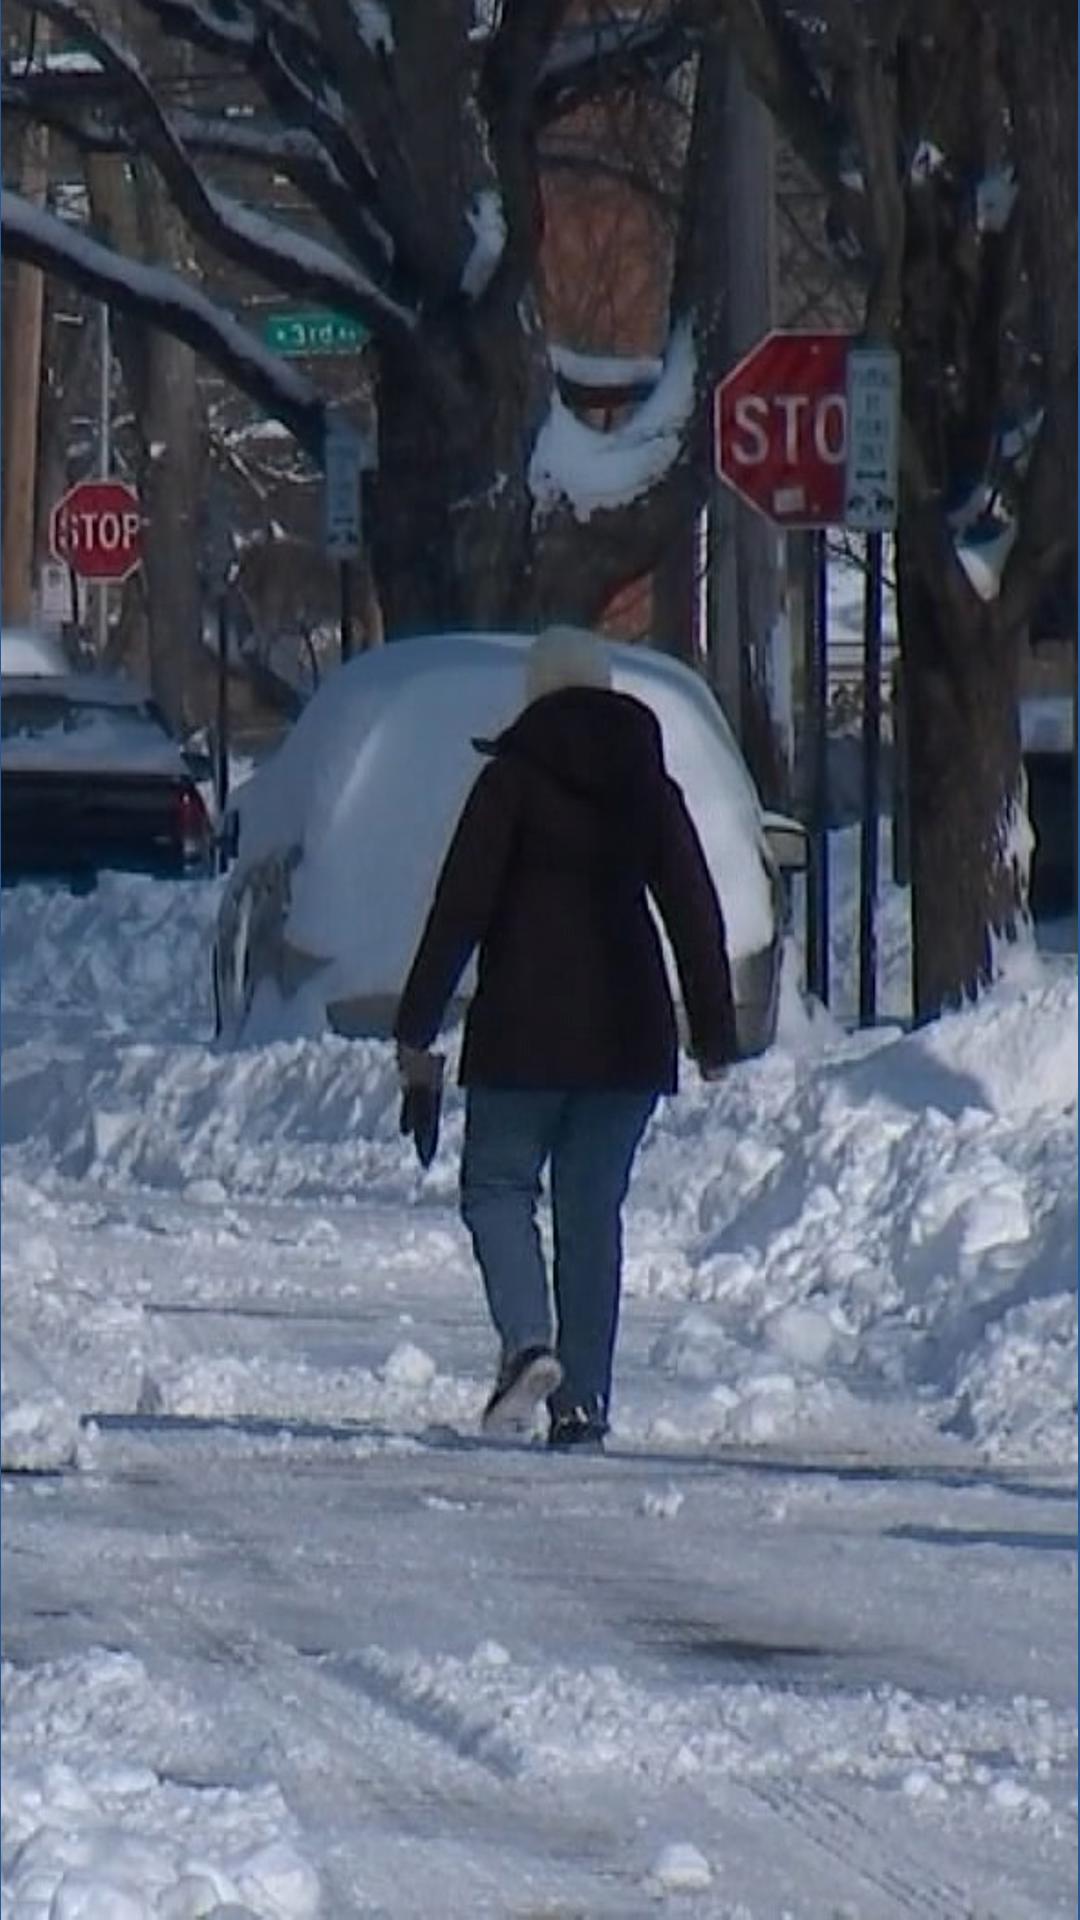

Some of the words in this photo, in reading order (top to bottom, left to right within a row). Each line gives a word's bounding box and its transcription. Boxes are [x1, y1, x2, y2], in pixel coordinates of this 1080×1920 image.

[291, 322, 333, 344] 3rd
[732, 394, 847, 464] STO
[58, 512, 139, 550] STOP
